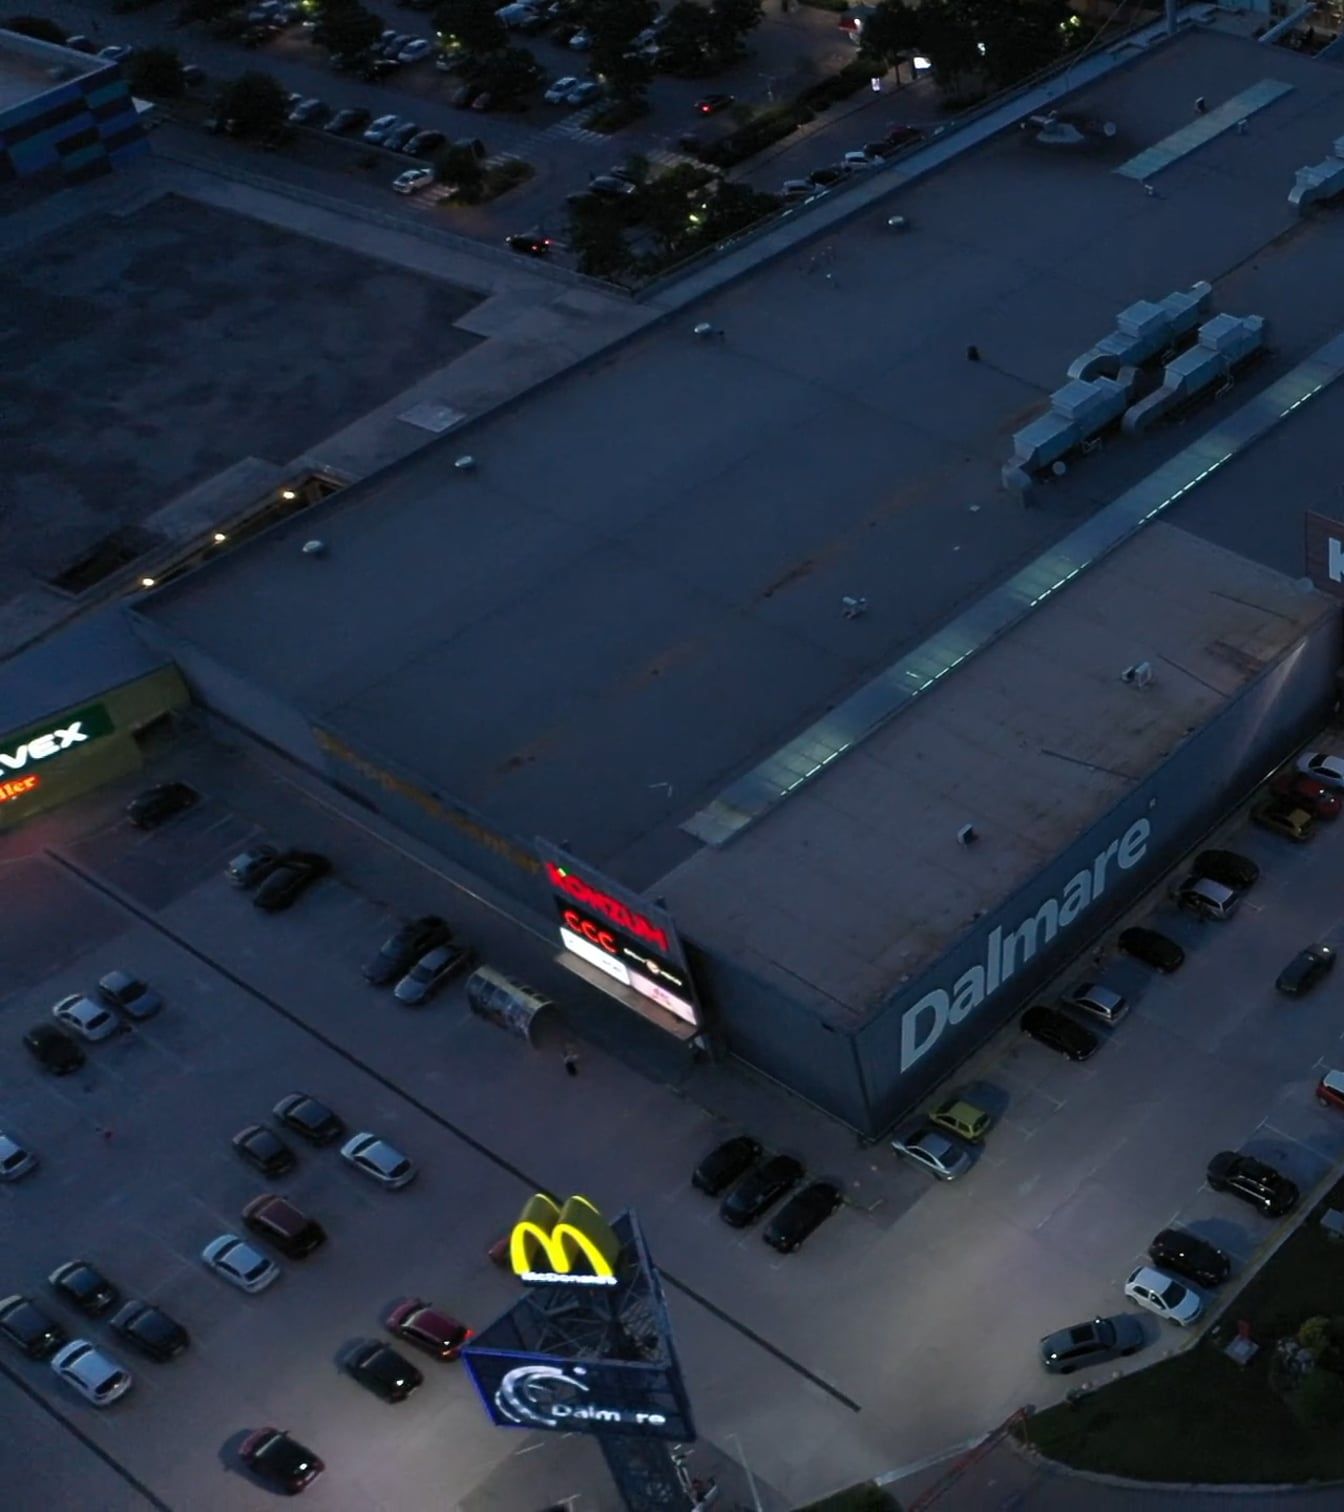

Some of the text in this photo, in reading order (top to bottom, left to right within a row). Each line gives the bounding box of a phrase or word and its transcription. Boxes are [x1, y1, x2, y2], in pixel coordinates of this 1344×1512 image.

[0, 721, 89, 776] VEX
[565, 911, 616, 953] CCC
[901, 818, 1150, 1075] Dalmare
[551, 1404, 667, 1426] Dalmre
